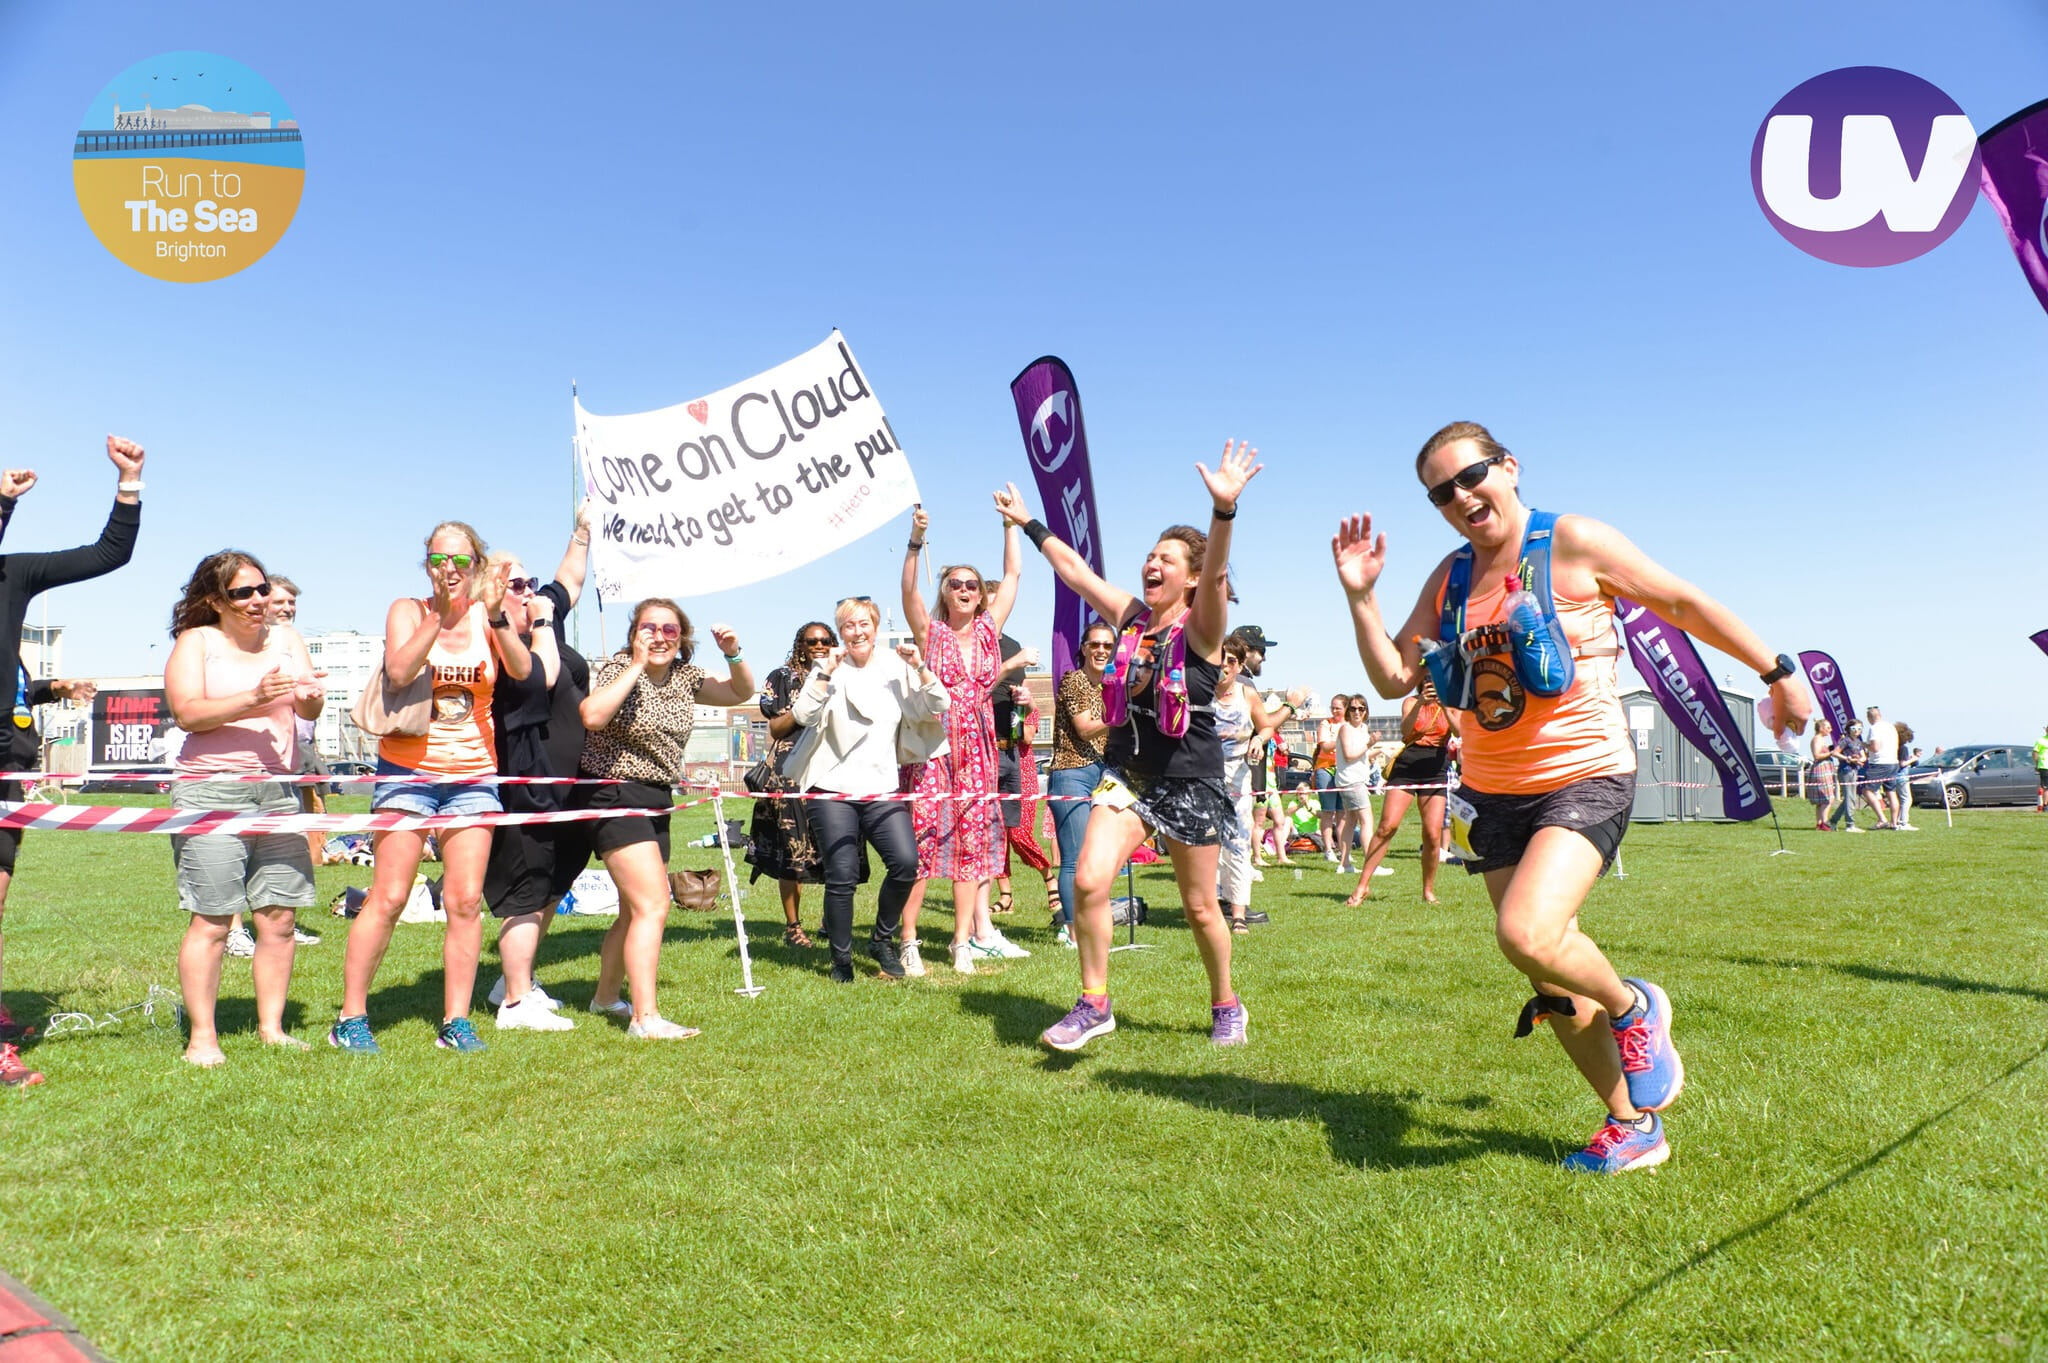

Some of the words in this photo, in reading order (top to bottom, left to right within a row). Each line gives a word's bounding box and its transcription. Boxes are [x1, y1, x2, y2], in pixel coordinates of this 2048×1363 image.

[677, 434, 736, 480] on
[731, 341, 870, 460] Cloud
[671, 512, 703, 547] to
[707, 493, 756, 546] get
[757, 482, 794, 514] to
[796, 456, 851, 494] the
[106, 697, 160, 725] HOME
[110, 724, 125, 744] IS
[126, 724, 153, 744] HER
[105, 744, 148, 761] FUTURE
